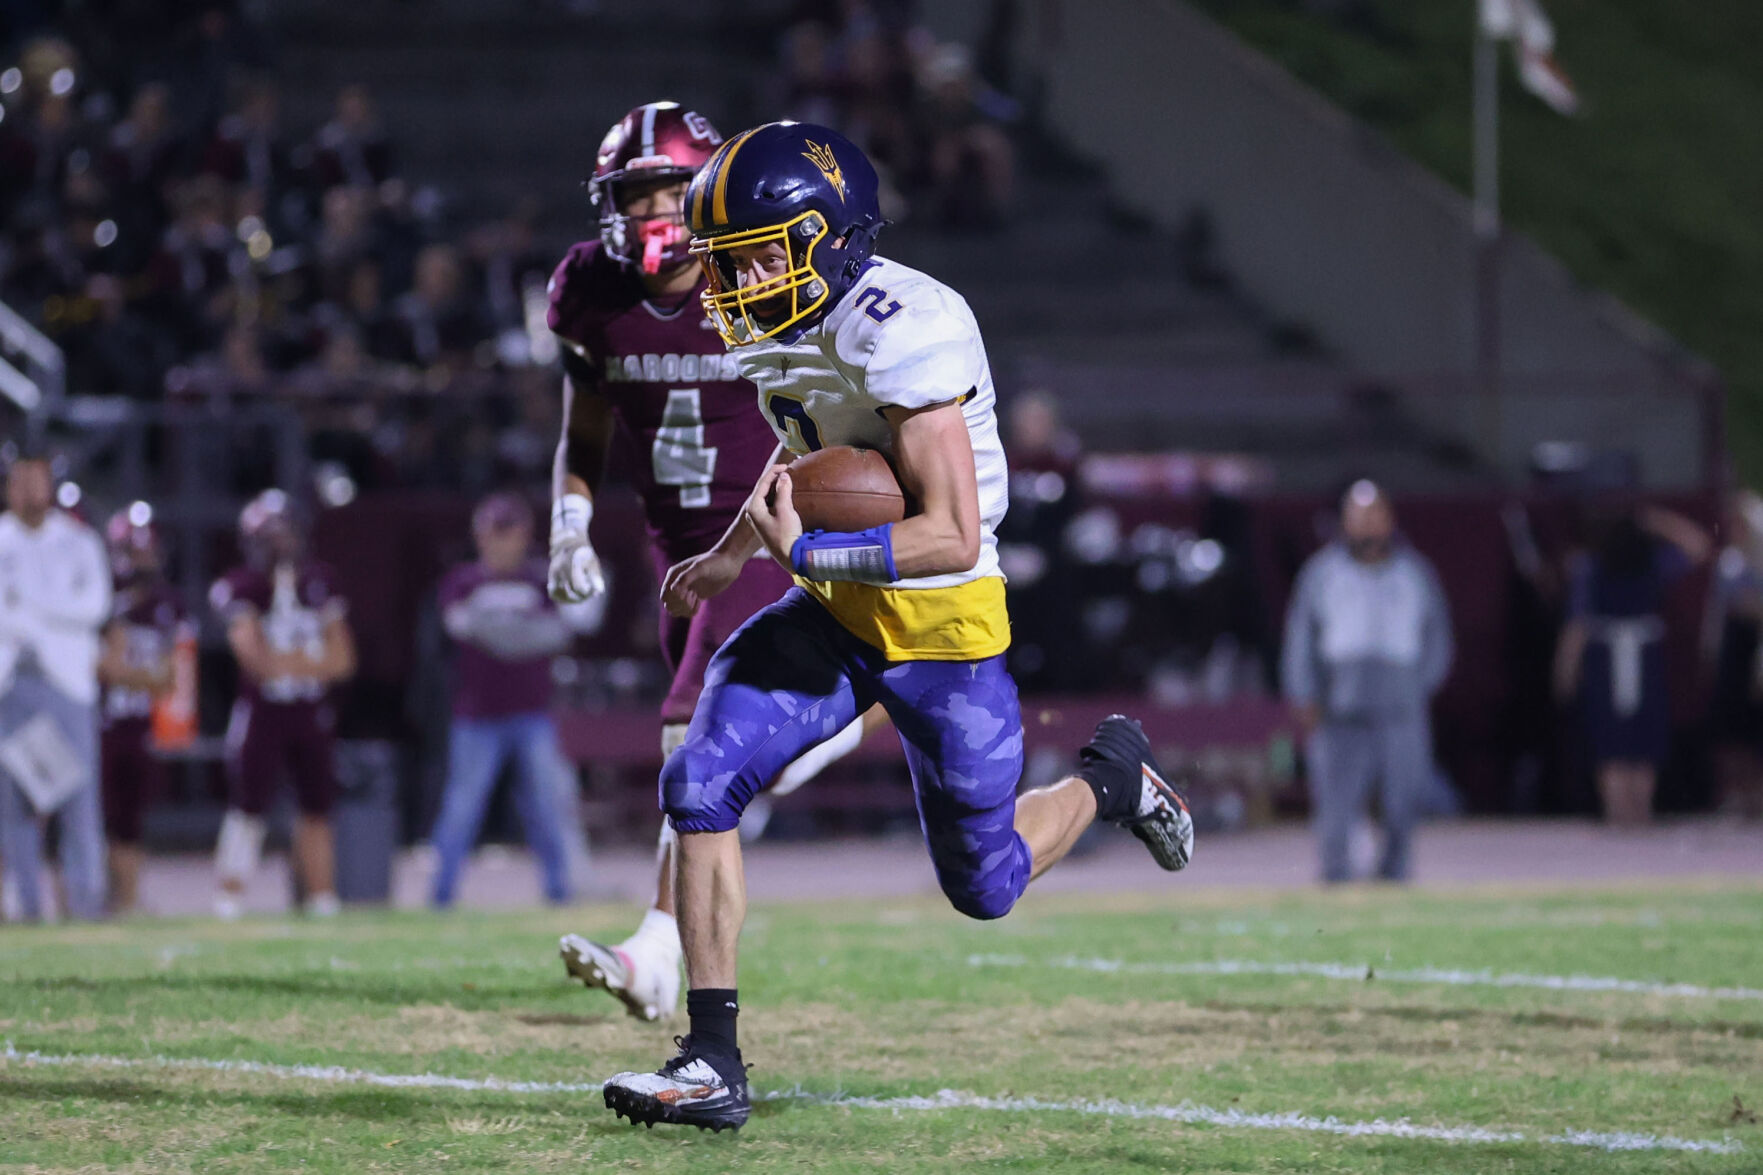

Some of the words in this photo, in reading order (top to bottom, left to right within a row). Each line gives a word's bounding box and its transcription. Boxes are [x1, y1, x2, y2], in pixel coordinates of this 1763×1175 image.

[854, 285, 904, 325] 2
[605, 353, 739, 383] MAROONS
[652, 388, 718, 508] 4
